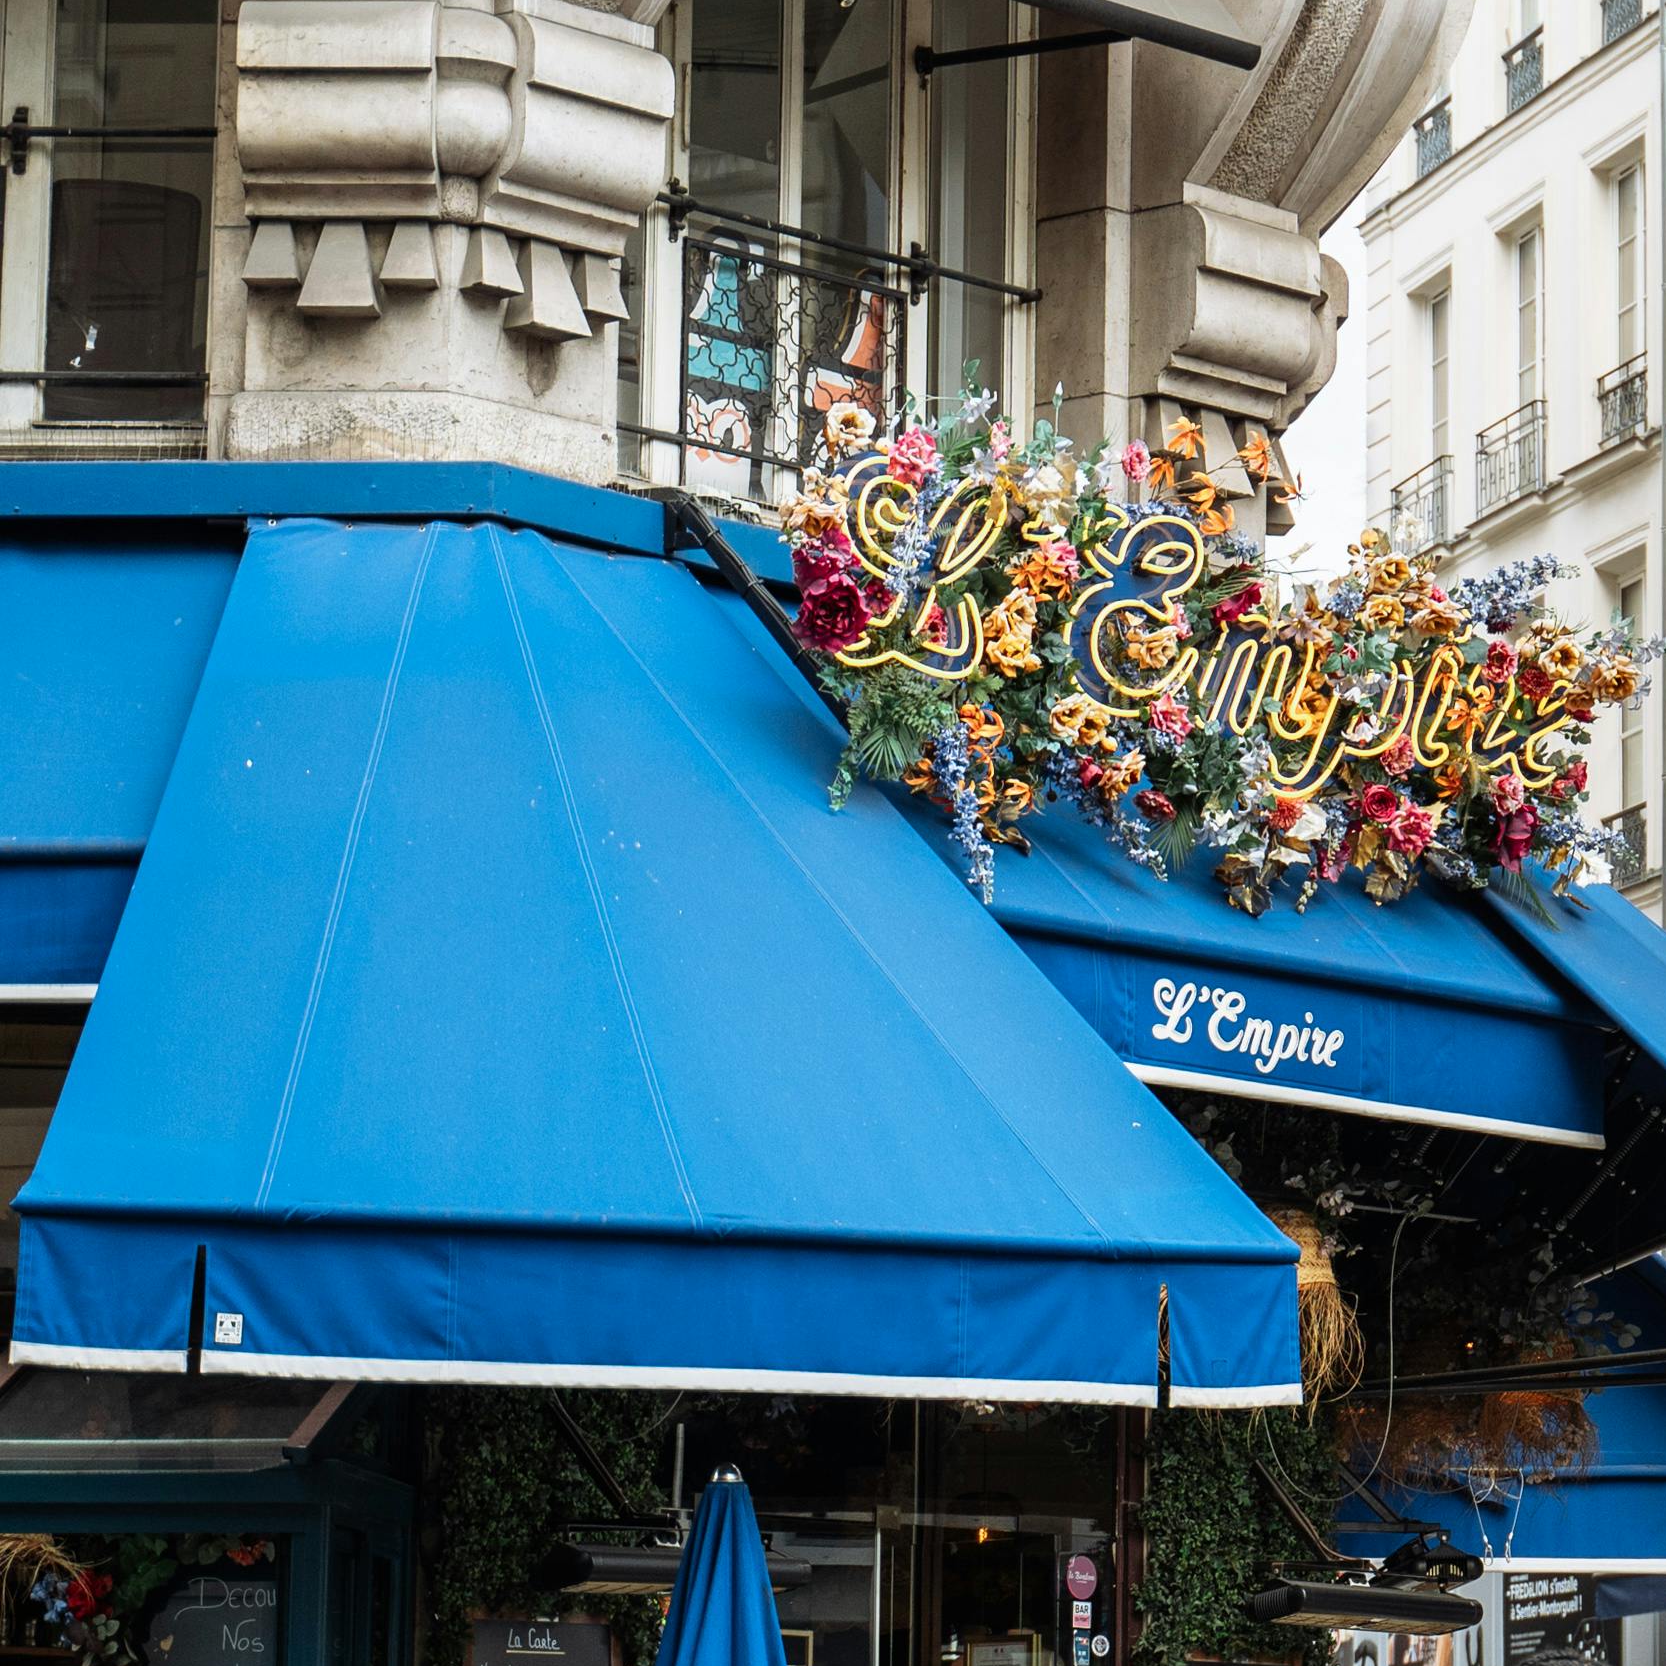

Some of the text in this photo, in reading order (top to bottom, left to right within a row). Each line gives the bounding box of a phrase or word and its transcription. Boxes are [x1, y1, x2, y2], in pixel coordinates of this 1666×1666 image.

[1151, 977, 1345, 1074] L'Empire
[1075, 1604, 1089, 1615] BAR
[528, 1627, 561, 1650] Carte
